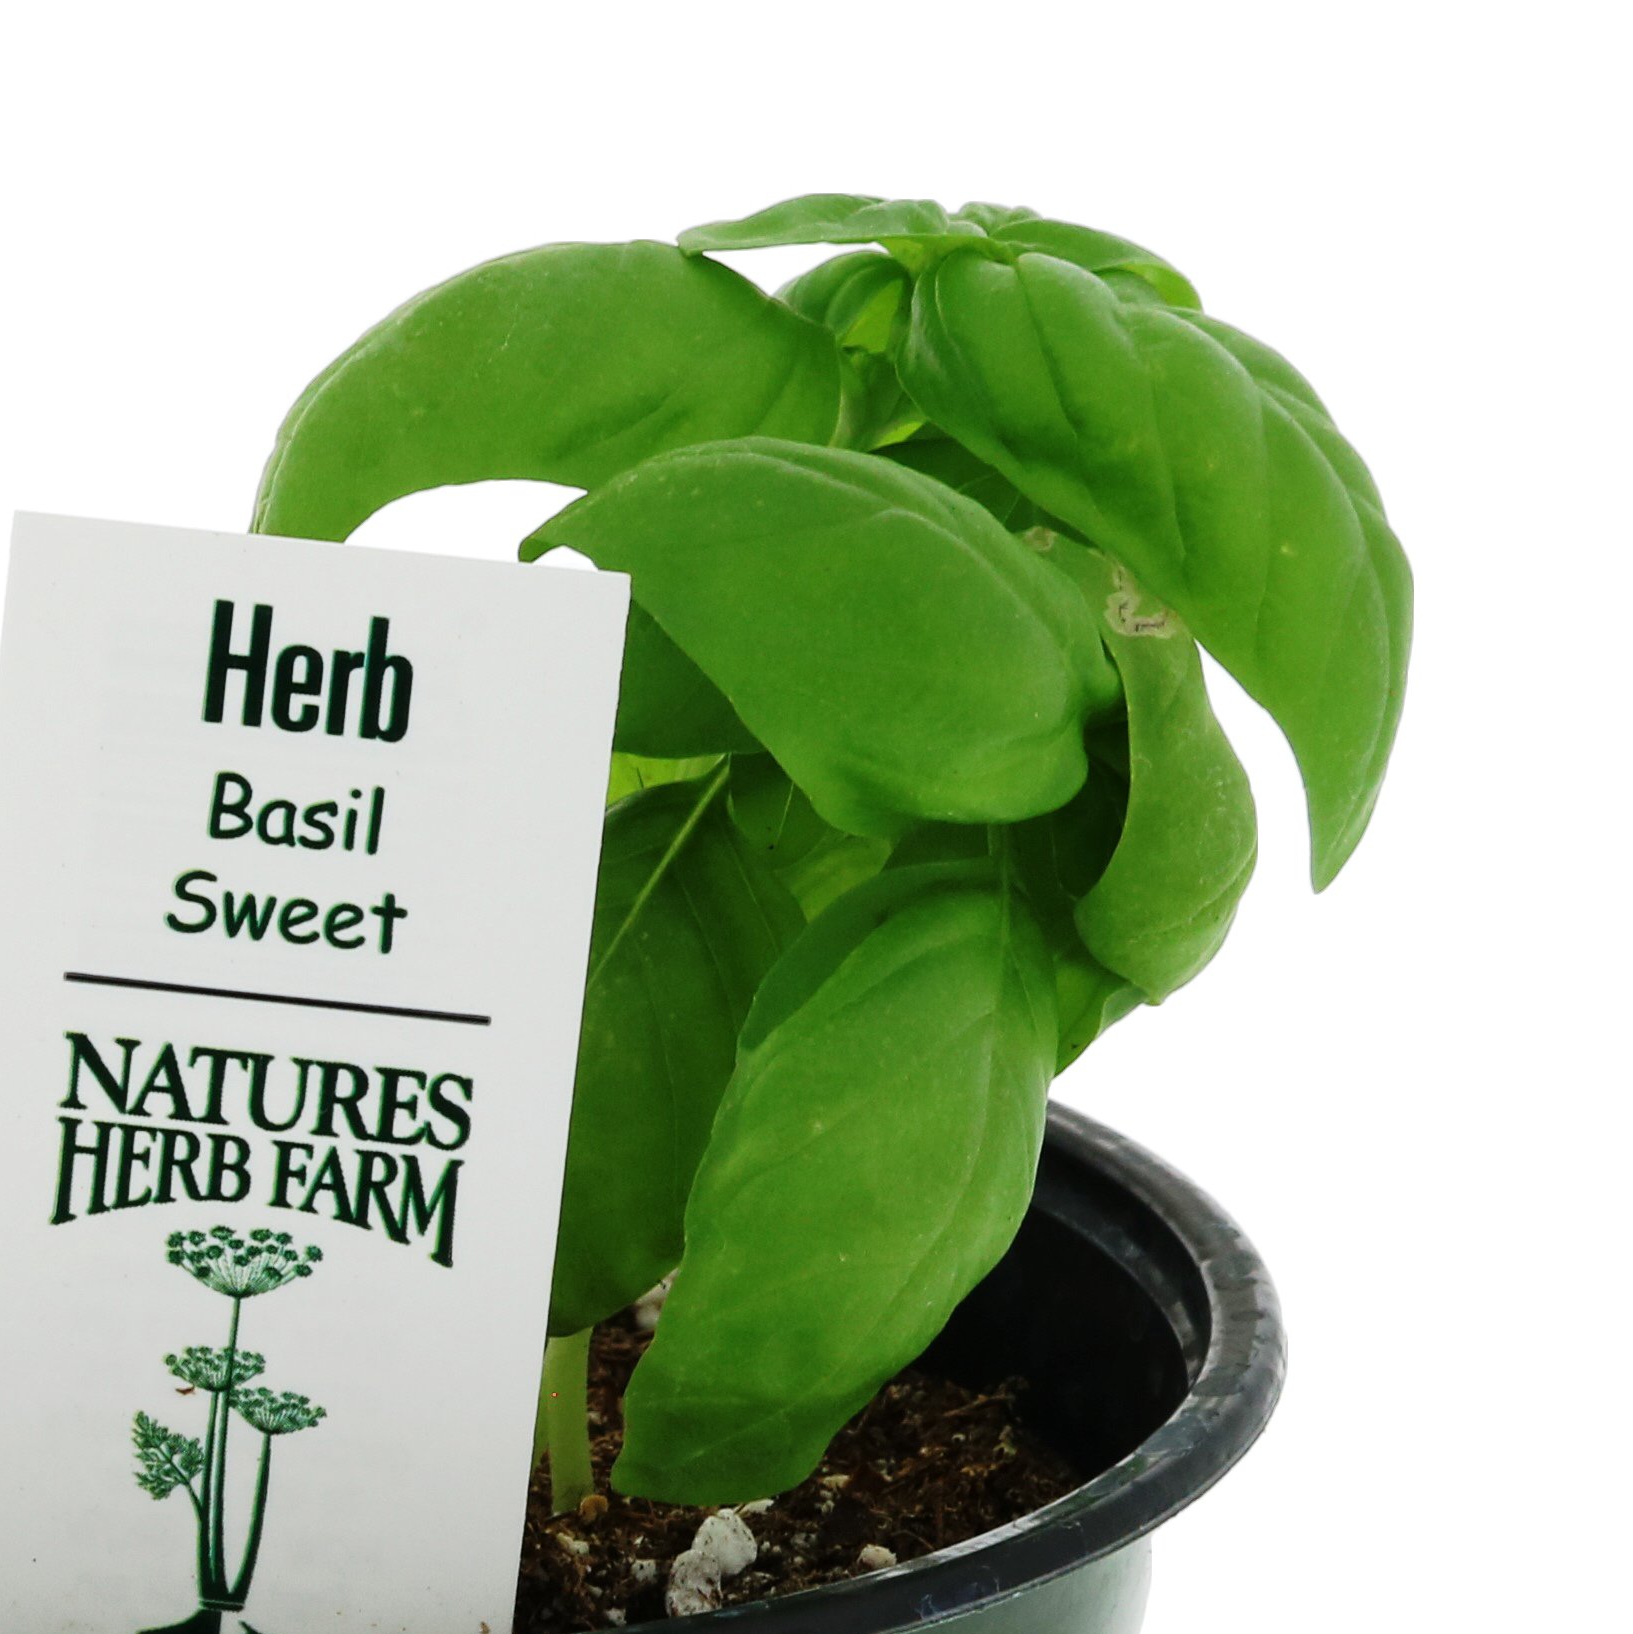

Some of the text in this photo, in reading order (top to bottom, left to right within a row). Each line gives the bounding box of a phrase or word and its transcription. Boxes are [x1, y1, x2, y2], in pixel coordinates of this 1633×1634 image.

[201, 597, 415, 744] Herb
[207, 770, 386, 856] Basil
[164, 868, 409, 955] Sweet
[58, 1030, 475, 1153] NATURES
[48, 1114, 466, 1270] HERB FARM
